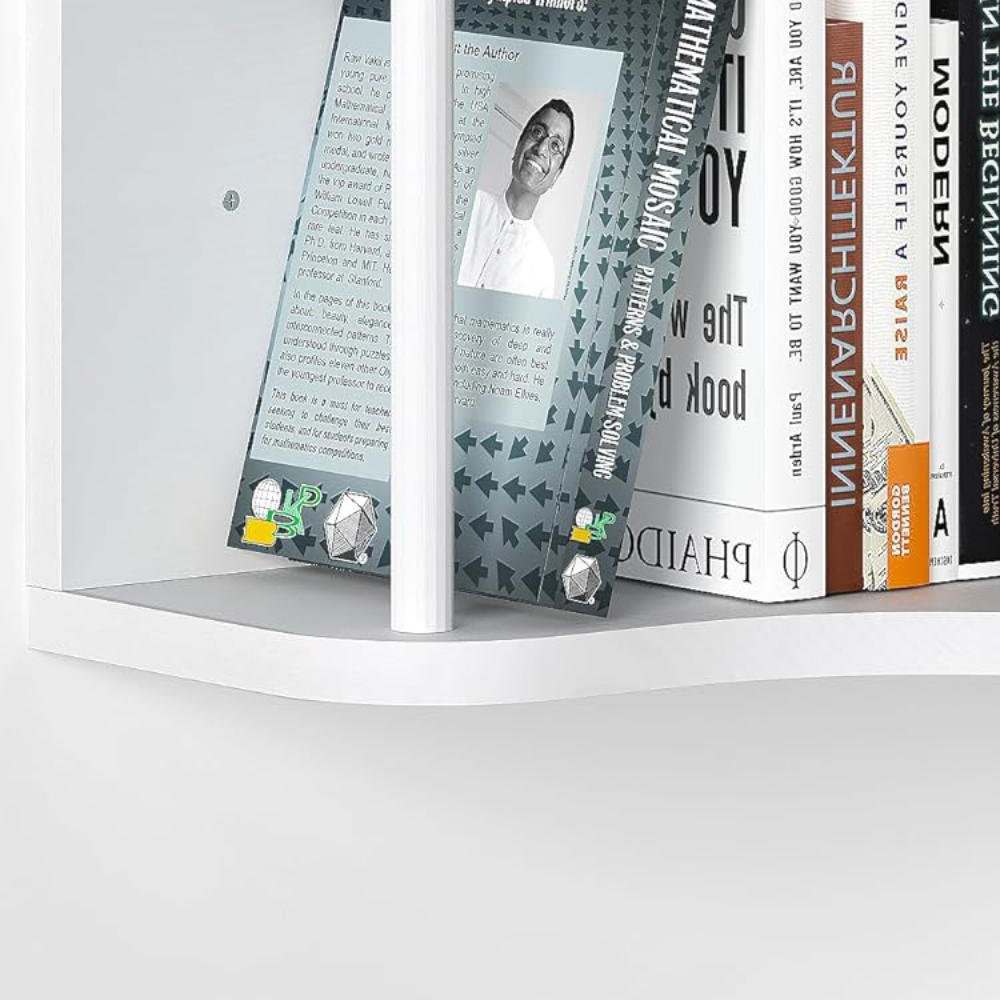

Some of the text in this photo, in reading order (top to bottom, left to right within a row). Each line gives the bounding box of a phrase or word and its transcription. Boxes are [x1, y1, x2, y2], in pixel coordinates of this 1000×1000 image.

[463, 43, 480, 57] the
[482, 45, 520, 61] Author
[636, 162, 683, 253] MOSAIC
[622, 263, 656, 337] PATTERNS
[606, 353, 637, 419] PROBLEM
[593, 419, 622, 480] SOLVING
